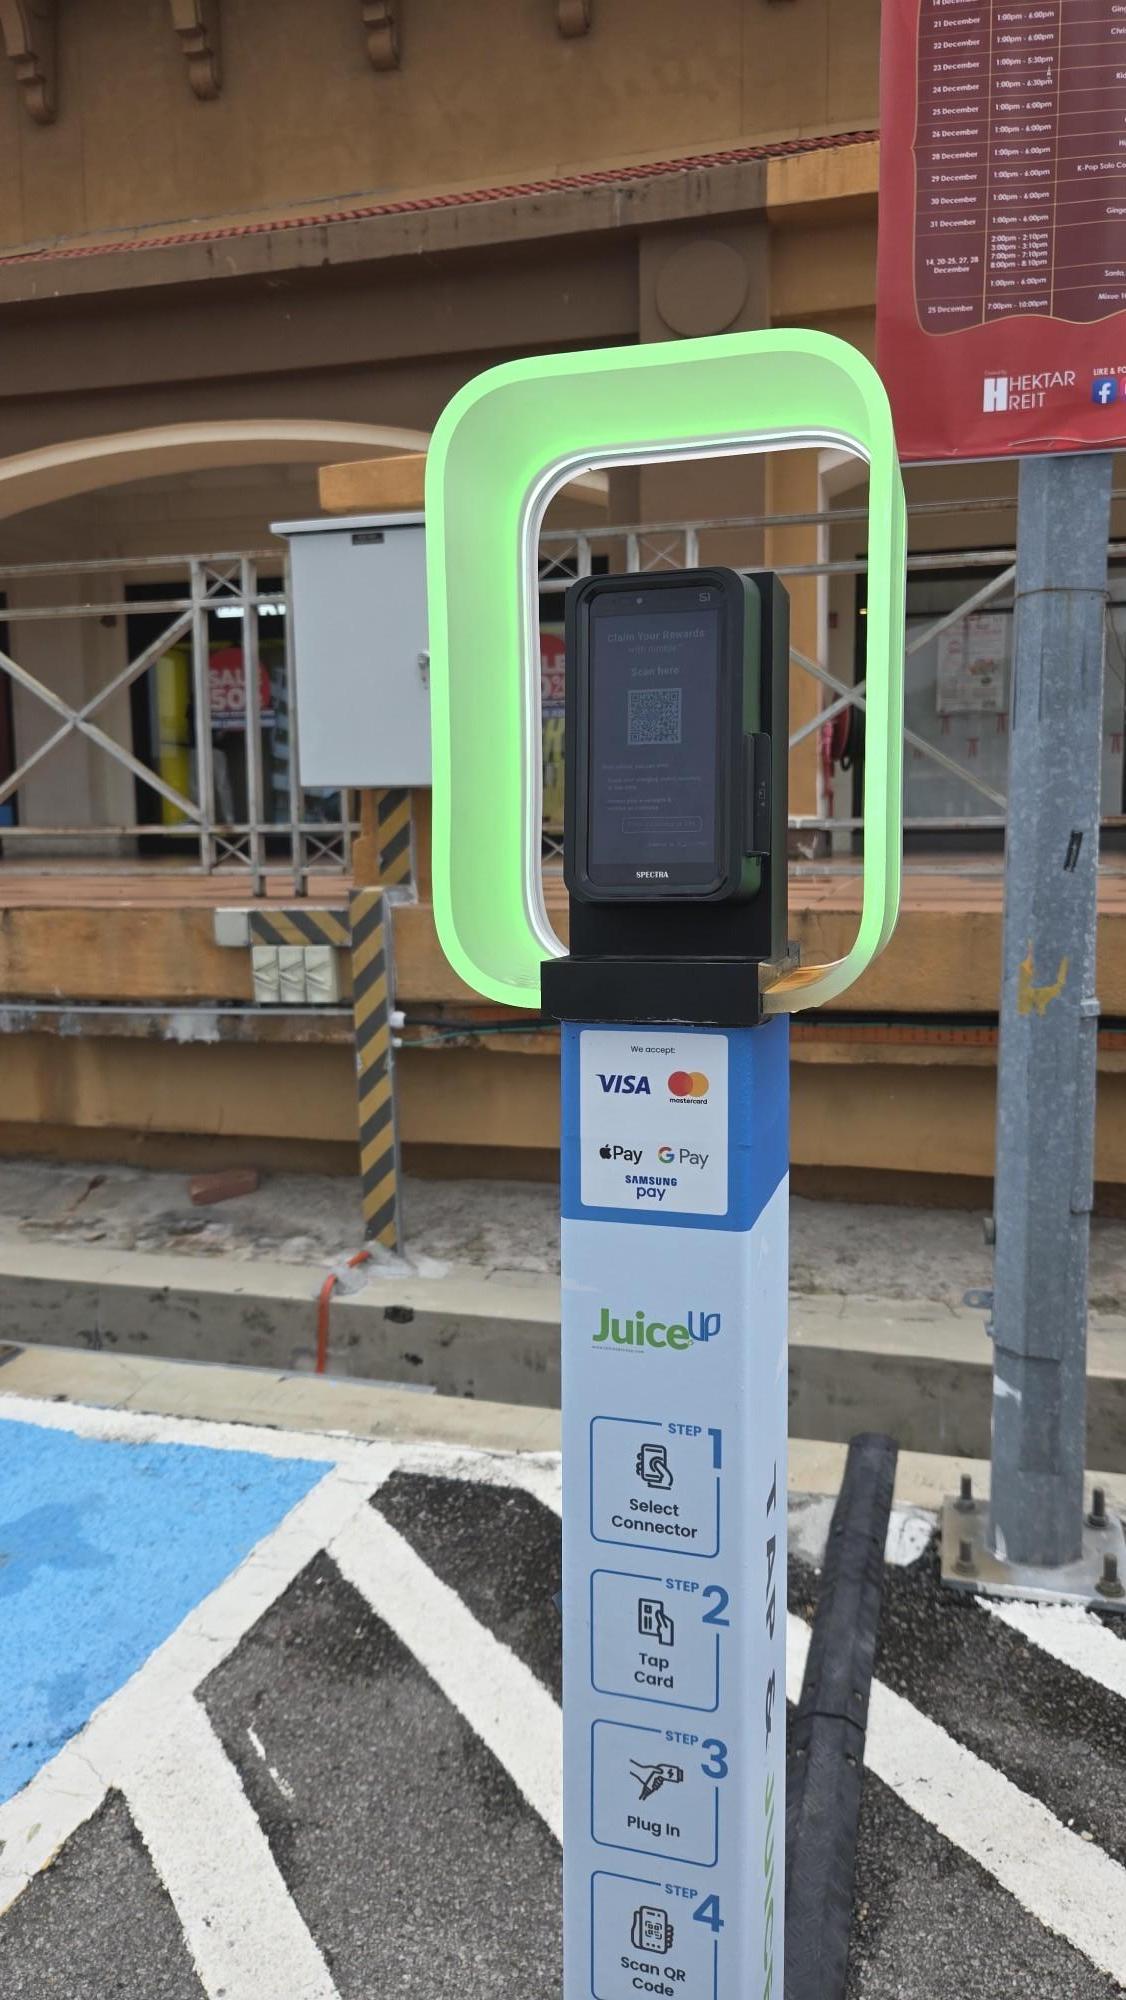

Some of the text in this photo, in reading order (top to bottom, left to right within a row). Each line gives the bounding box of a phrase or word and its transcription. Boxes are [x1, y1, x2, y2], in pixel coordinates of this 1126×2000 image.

[943, 17, 981, 27] December
[942, 39, 980, 49] December
[942, 61, 980, 71] December
[942, 83, 980, 93] December
[941, 106, 979, 115] December
[941, 128, 979, 137] December
[941, 151, 978, 160] December
[940, 174, 978, 182] December
[940, 196, 977, 205] December
[939, 219, 976, 228] December
[933, 266, 970, 274] December
[937, 304, 974, 313] December
[1093, 367, 1109, 376] LIKE
[1110, 366, 1116, 375] &
[1009, 370, 1076, 391] HEKTAR
[1009, 392, 1046, 410] REIT
[637, 631, 659, 642] Your
[662, 628, 705, 640] Rewards
[631, 666, 655, 677] Scan
[636, 871, 669, 879] SPECTRA
[630, 1044, 676, 1055] We accept:
[595, 1073, 651, 1095] VISA
[669, 1097, 708, 1105] mastercard
[613, 1145, 643, 1165] Pay
[679, 1148, 709, 1169] Pay
[625, 1174, 678, 1187] SAMSUNG
[636, 1186, 666, 1201] pay
[668, 1422, 722, 1470] STEP 1
[629, 1497, 680, 1517] Select
[611, 1515, 698, 1539] Connector
[765, 1460, 777, 1641] TAP
[665, 1578, 730, 1627] STEP 2
[638, 1651, 670, 1673] Tap
[634, 1670, 674, 1689] Card
[665, 1730, 728, 1780] STEP 3
[627, 1815, 681, 1838] Plug In
[664, 1883, 725, 1933] STEP 4
[620, 1956, 686, 1983] Scan QR
[631, 1976, 675, 1997] Code
